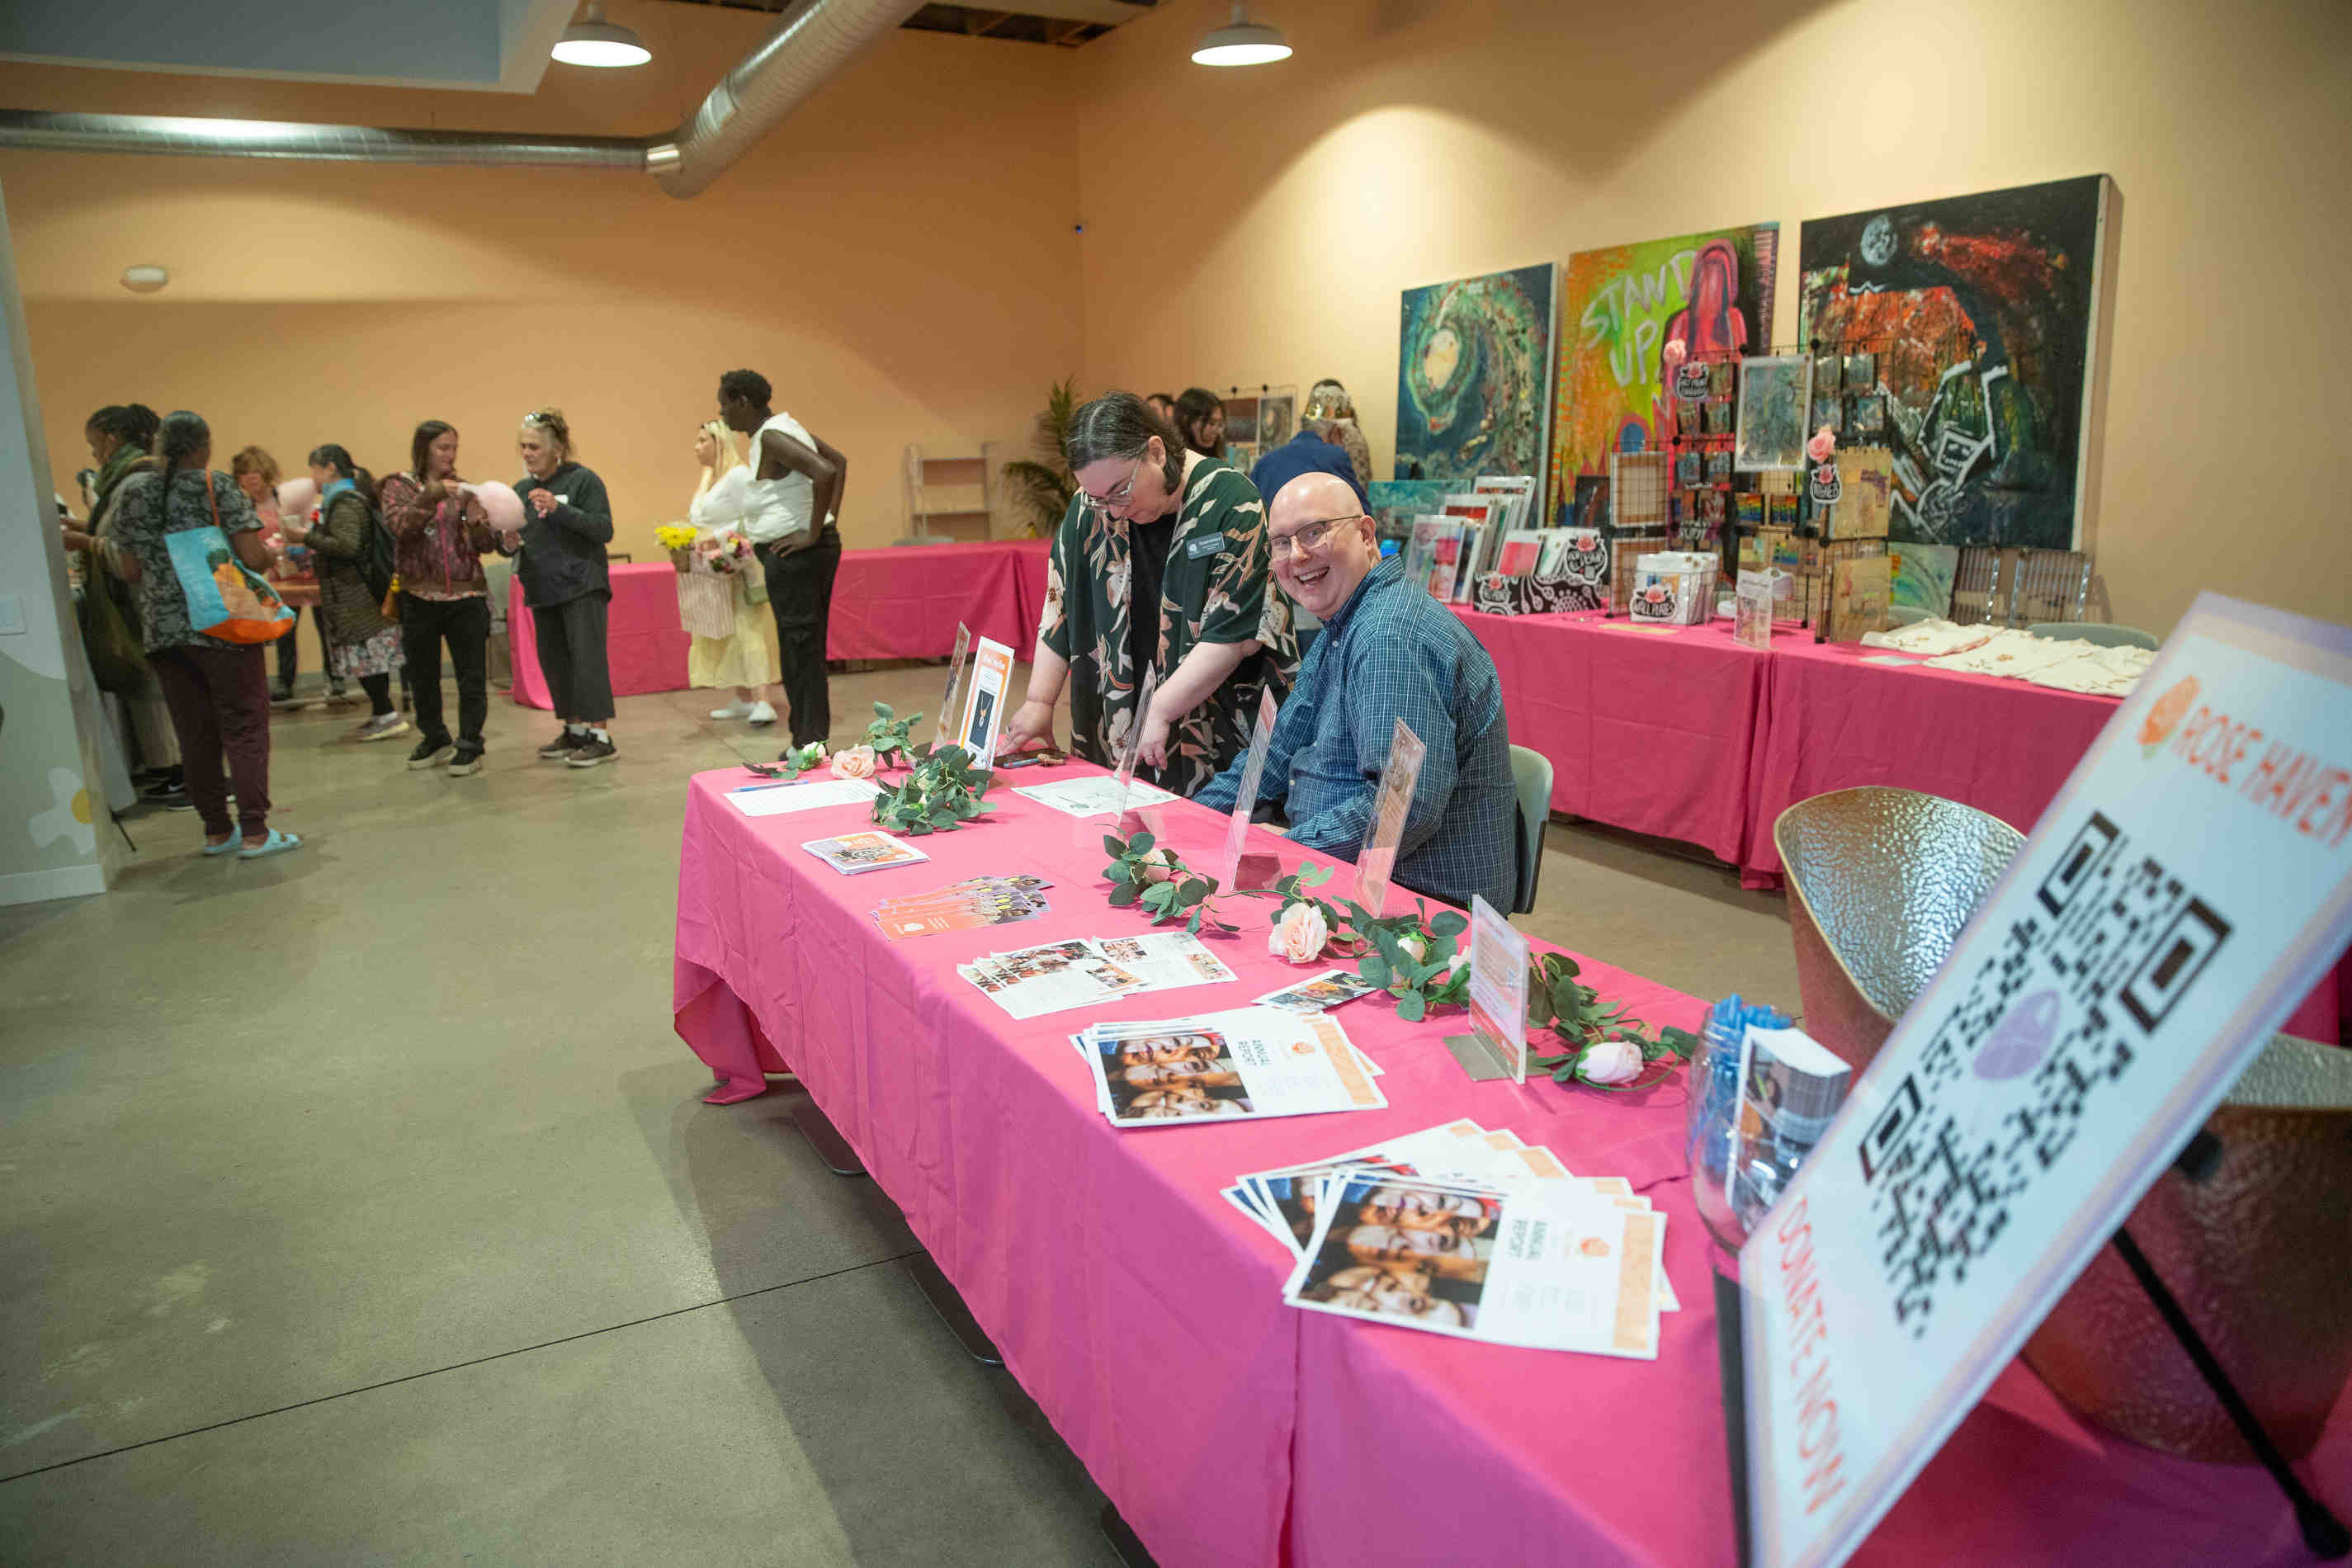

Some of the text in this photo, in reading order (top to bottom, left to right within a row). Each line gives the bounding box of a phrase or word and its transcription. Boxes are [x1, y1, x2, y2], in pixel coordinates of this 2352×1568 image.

[1580, 249, 1697, 351] STAND
[1610, 320, 1659, 387] UP
[2170, 704, 2352, 852] ROSE HAVEN
[1777, 1196, 1848, 1516] DONATE NOW
